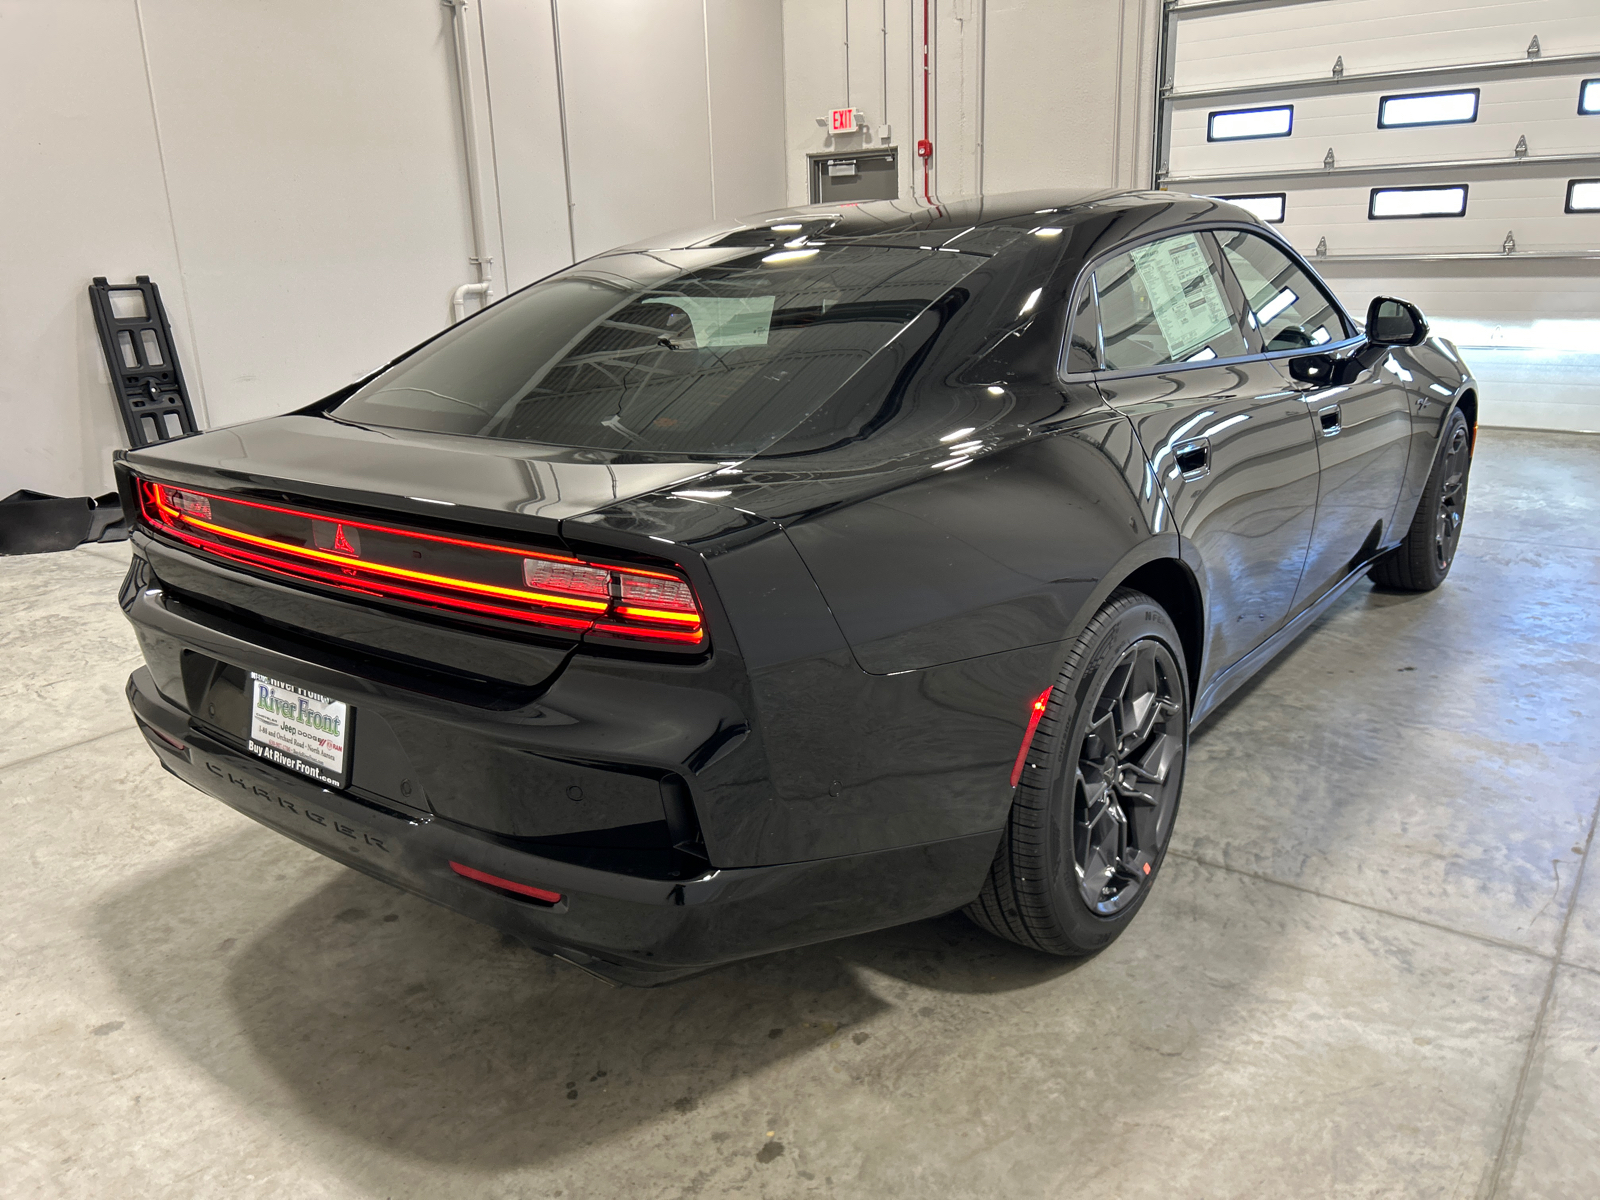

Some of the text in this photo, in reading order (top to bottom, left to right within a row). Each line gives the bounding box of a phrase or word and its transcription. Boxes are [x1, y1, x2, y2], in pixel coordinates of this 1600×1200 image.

[833, 109, 852, 130] EXIT
[257, 684, 341, 737] River Front
[280, 722, 297, 735] Jeep
[268, 730, 276, 738] and
[276, 732, 293, 744] Orchard
[294, 739, 304, 748] Road
[307, 744, 320, 754] North
[332, 744, 342, 752] RAM
[248, 739, 263, 757] Buy
[263, 745, 273, 760] At
[274, 749, 295, 769] River
[296, 759, 340, 787] Front.com
[206, 761, 390, 852] CHARGER
